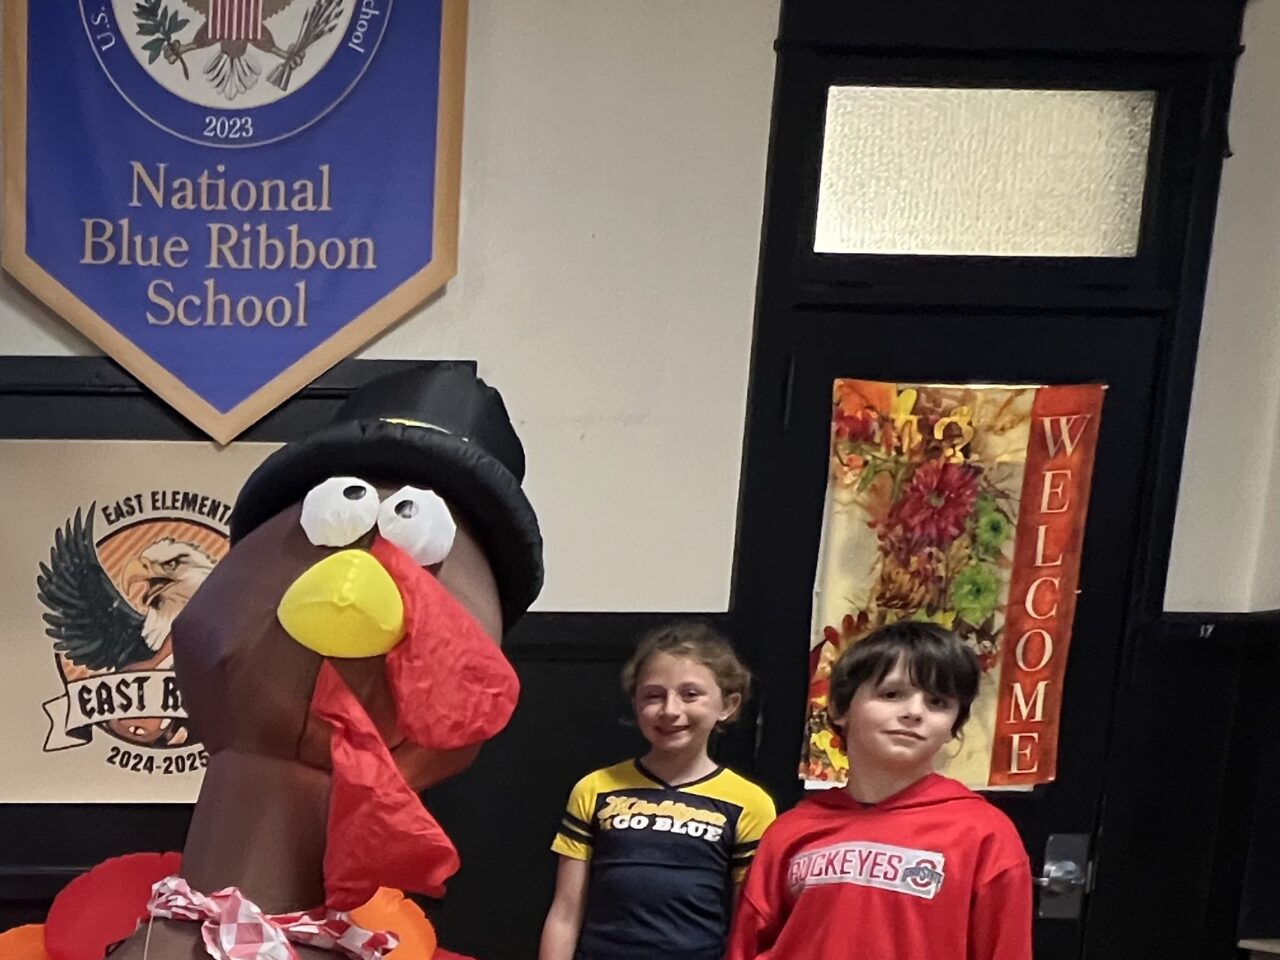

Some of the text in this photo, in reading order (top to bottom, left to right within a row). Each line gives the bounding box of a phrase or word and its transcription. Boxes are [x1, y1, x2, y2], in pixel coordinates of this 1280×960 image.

[348, 0, 379, 53] chool
[202, 116, 254, 139] 2023
[128, 160, 332, 212] National
[79, 217, 377, 270] Blue Ribbon
[146, 279, 309, 328] School
[101, 493, 144, 526] EAST
[1007, 414, 1092, 774] WELCOME
[77, 676, 149, 719] EAST
[106, 745, 209, 775] 2024-2025
[612, 815, 723, 841] GO BLUE
[790, 849, 903, 886] BUCKEYES
